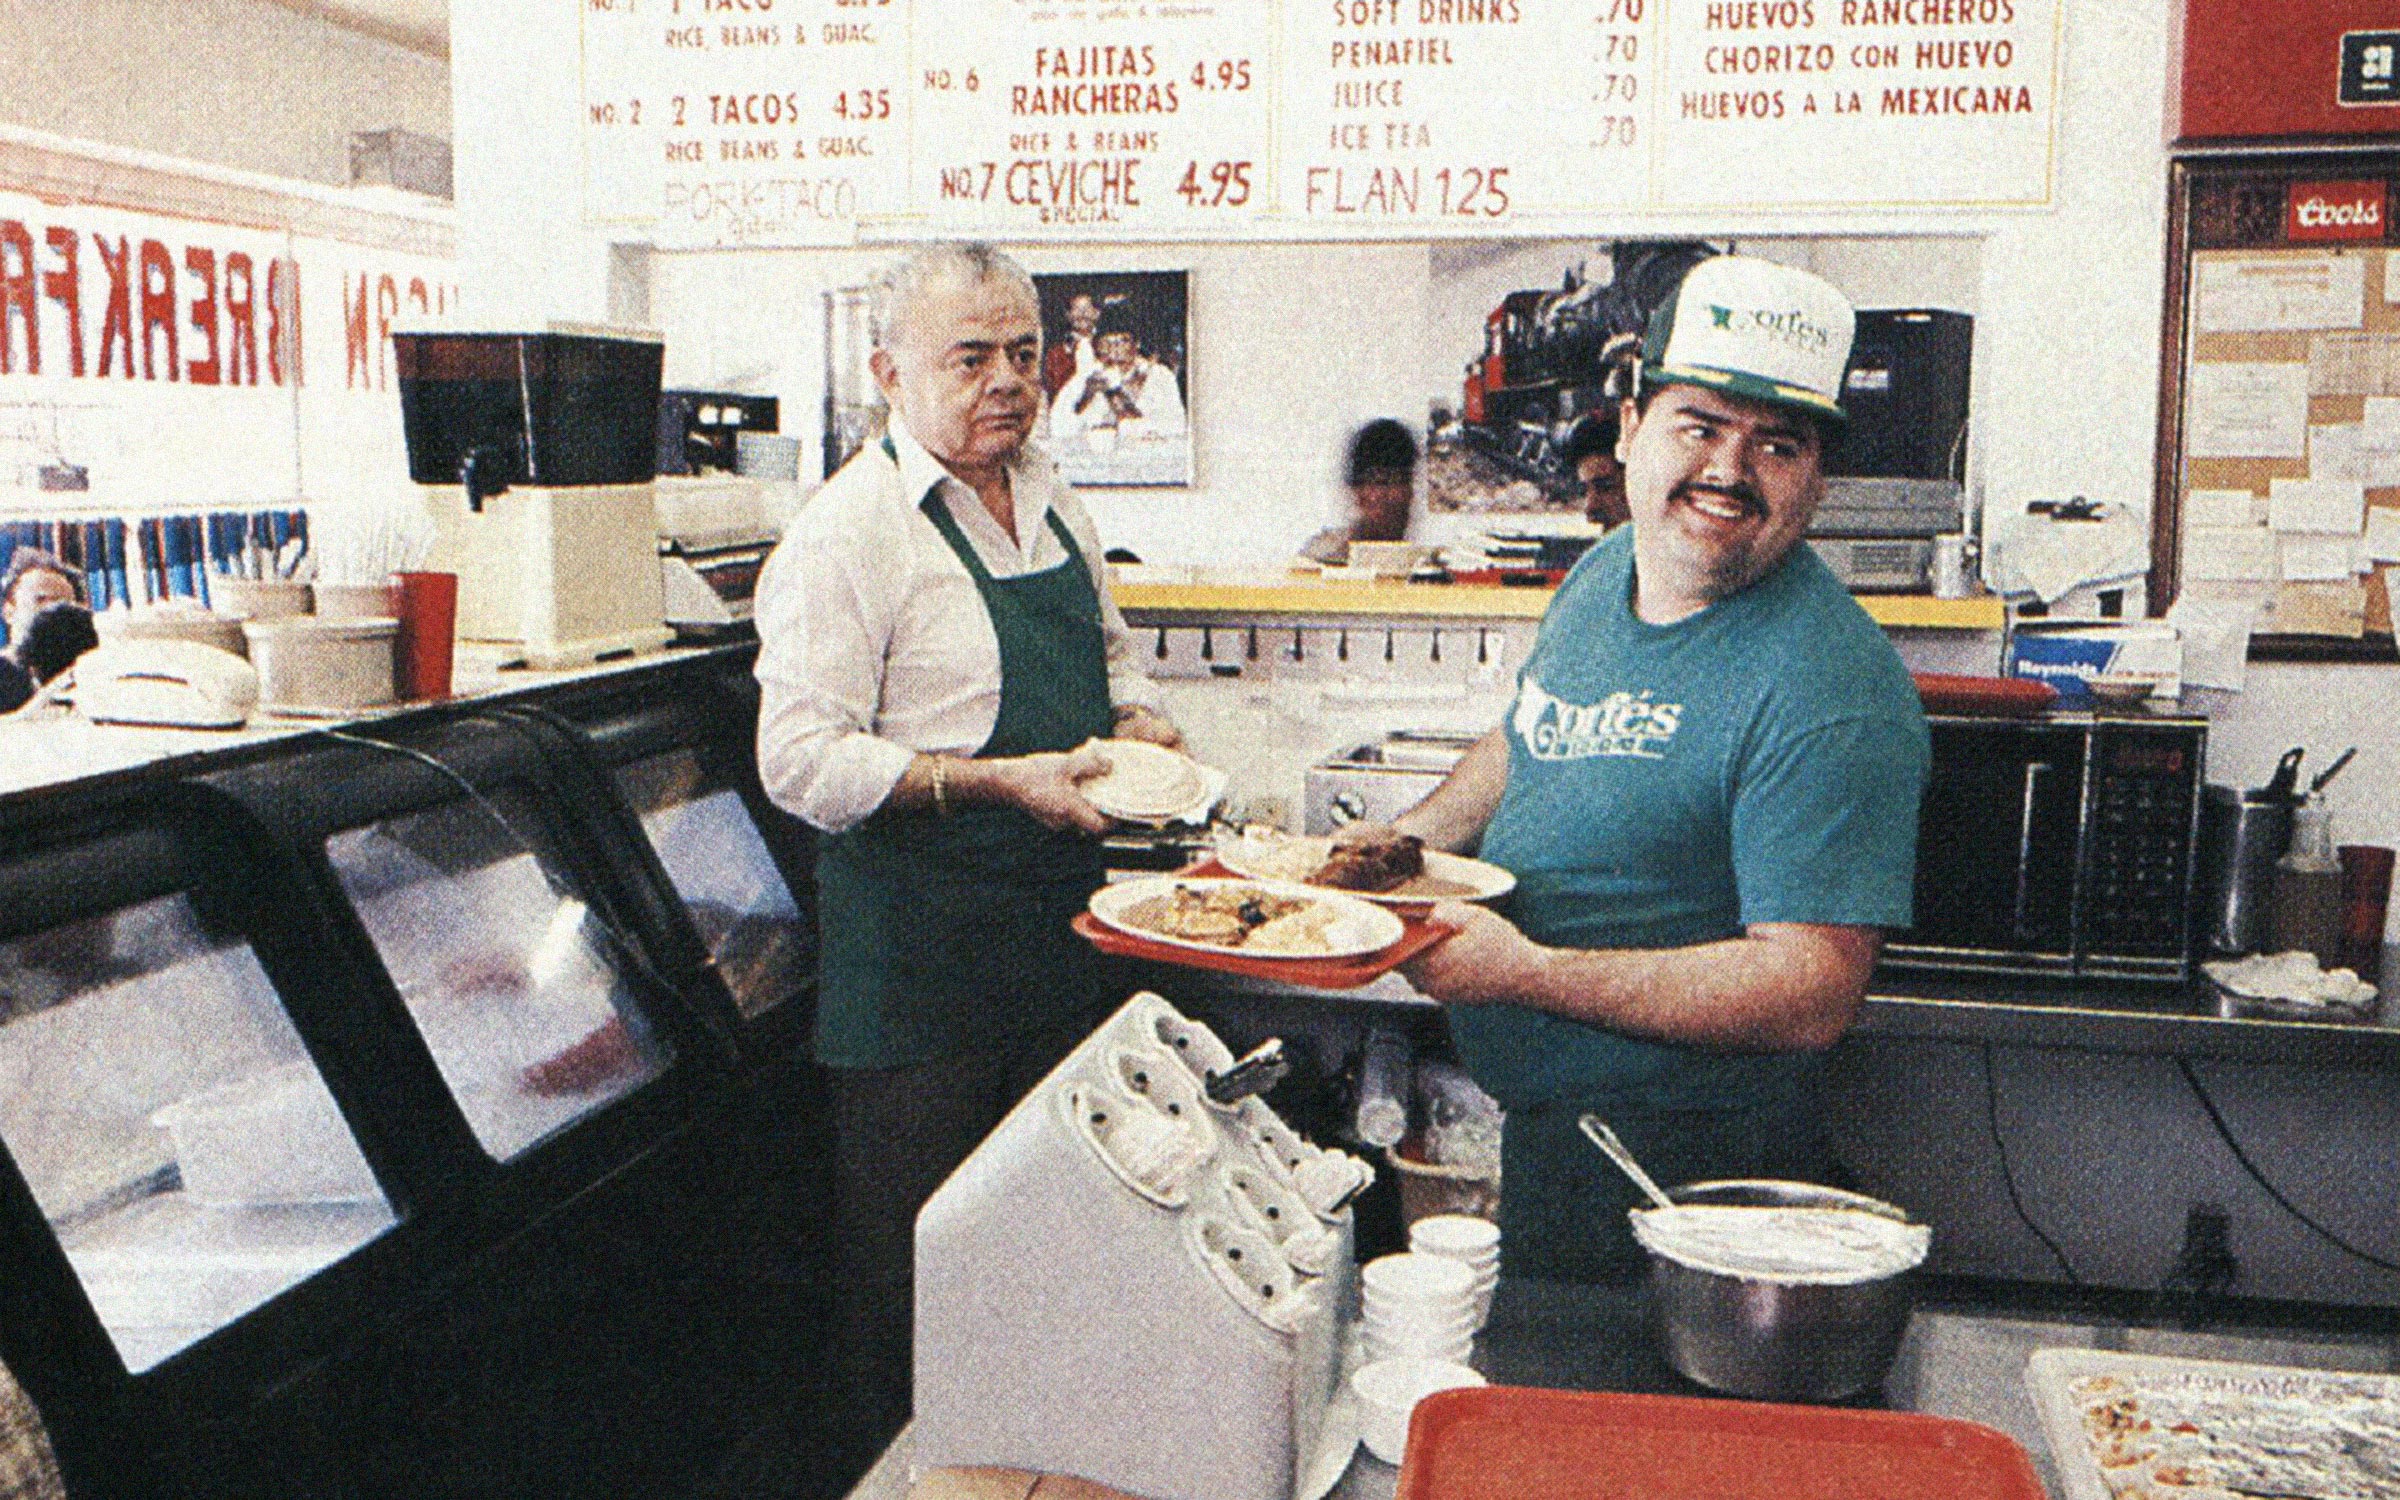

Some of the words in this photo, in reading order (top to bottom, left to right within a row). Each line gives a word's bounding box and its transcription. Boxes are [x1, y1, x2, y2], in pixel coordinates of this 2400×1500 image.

[1333, 0, 1400, 28] SOFT
[1419, 0, 1520, 25] DRINKS
[1706, 0, 1815, 31] HUEVOS
[1842, 0, 2014, 26] RANCHEROS
[721, 27, 781, 47] BEANS
[1035, 45, 1157, 78] FAJITAS
[1191, 59, 1251, 92] 4.95
[1331, 38, 1454, 69] PENAFIEL
[1705, 43, 1835, 75] CHORIZO
[1850, 45, 1899, 69] CON
[1915, 39, 2013, 70] HUEVO
[924, 68, 957, 91] NO.
[965, 69, 980, 93] 6
[1333, 79, 1403, 109] JUICE
[1592, 73, 1638, 103] .70
[590, 102, 620, 125] NO.
[630, 99, 642, 126] 2
[672, 96, 686, 128] 2
[709, 93, 798, 126] TACOS
[833, 89, 891, 121] 4.35
[1012, 82, 1179, 116] RANCHERAS
[1682, 89, 1786, 120] HUEVOS
[1803, 93, 1818, 114] A
[1834, 91, 1862, 114] LA
[1881, 86, 2033, 115] MEXICANA
[665, 140, 704, 163] RICE
[720, 140, 779, 161] BEANS
[793, 140, 806, 160] &
[818, 136, 873, 159] GUAC.
[1009, 132, 1051, 153] RICE
[1067, 131, 1079, 153] &
[1094, 131, 1158, 152] BEANS
[1329, 123, 1370, 152] ICE
[1384, 121, 1431, 150] TEA
[1005, 159, 1141, 206] CEVICHE
[1176, 160, 1253, 208] 4.95
[1306, 167, 1419, 215] FLAN
